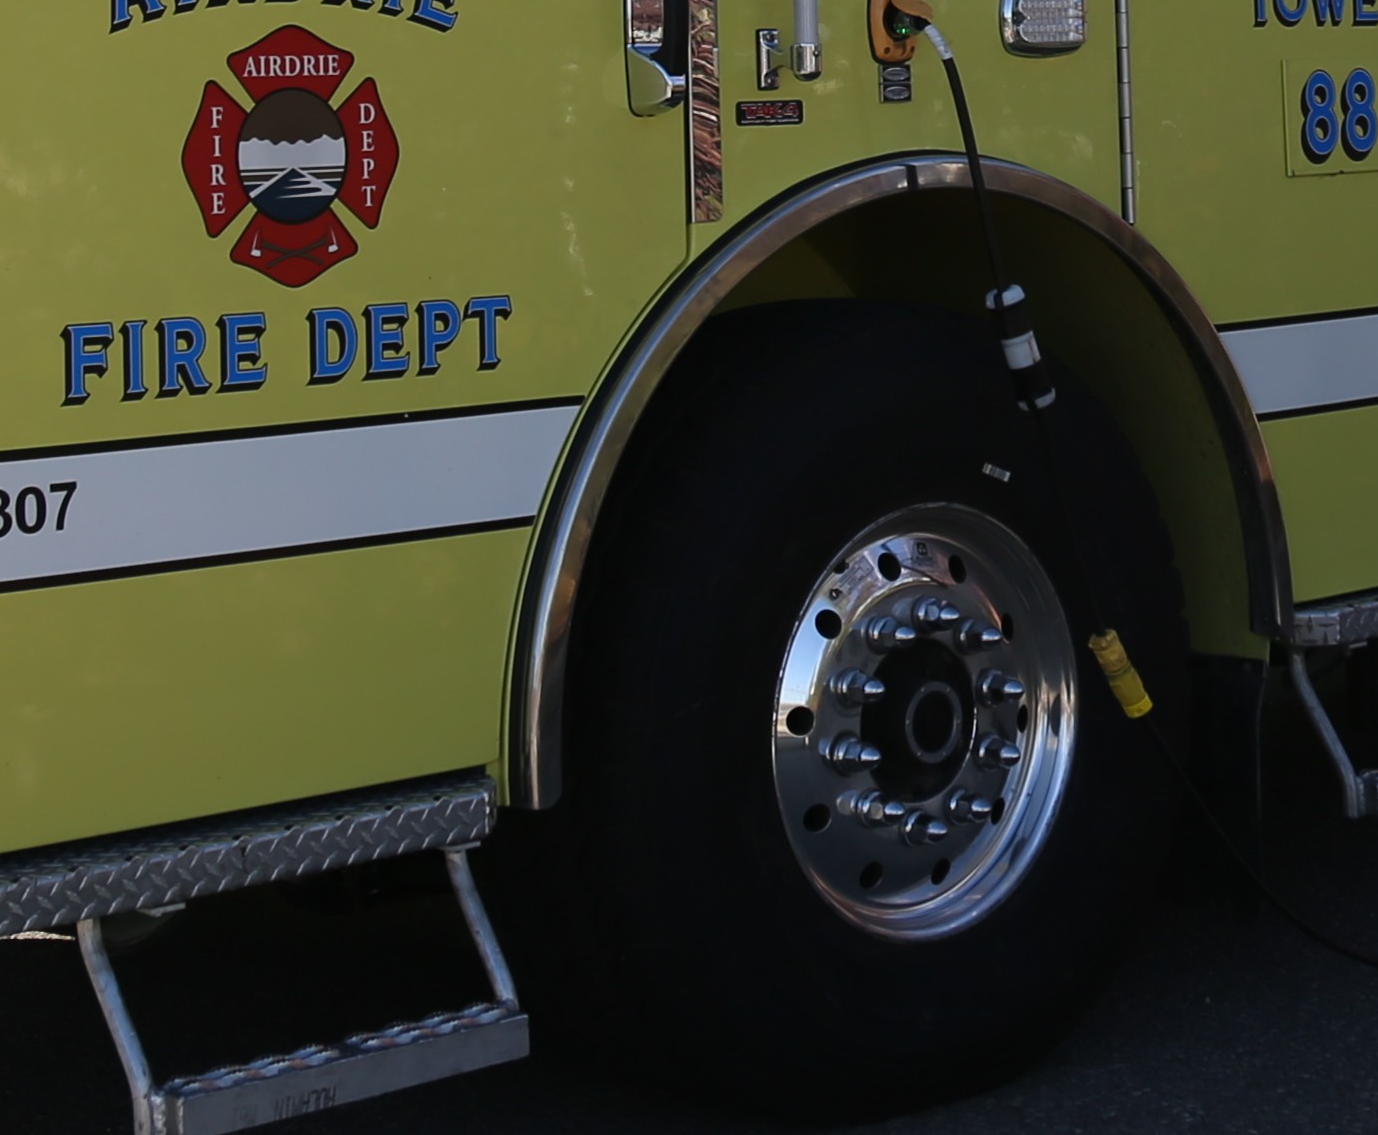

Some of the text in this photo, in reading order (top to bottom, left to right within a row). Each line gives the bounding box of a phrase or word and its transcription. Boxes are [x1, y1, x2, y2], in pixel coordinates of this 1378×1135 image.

[242, 54, 341, 78] AIRDRIE
[1299, 67, 1378, 165] 88
[210, 106, 227, 215] FIRE
[359, 102, 376, 208] DEPT
[59, 294, 513, 408] FIRE DEPT
